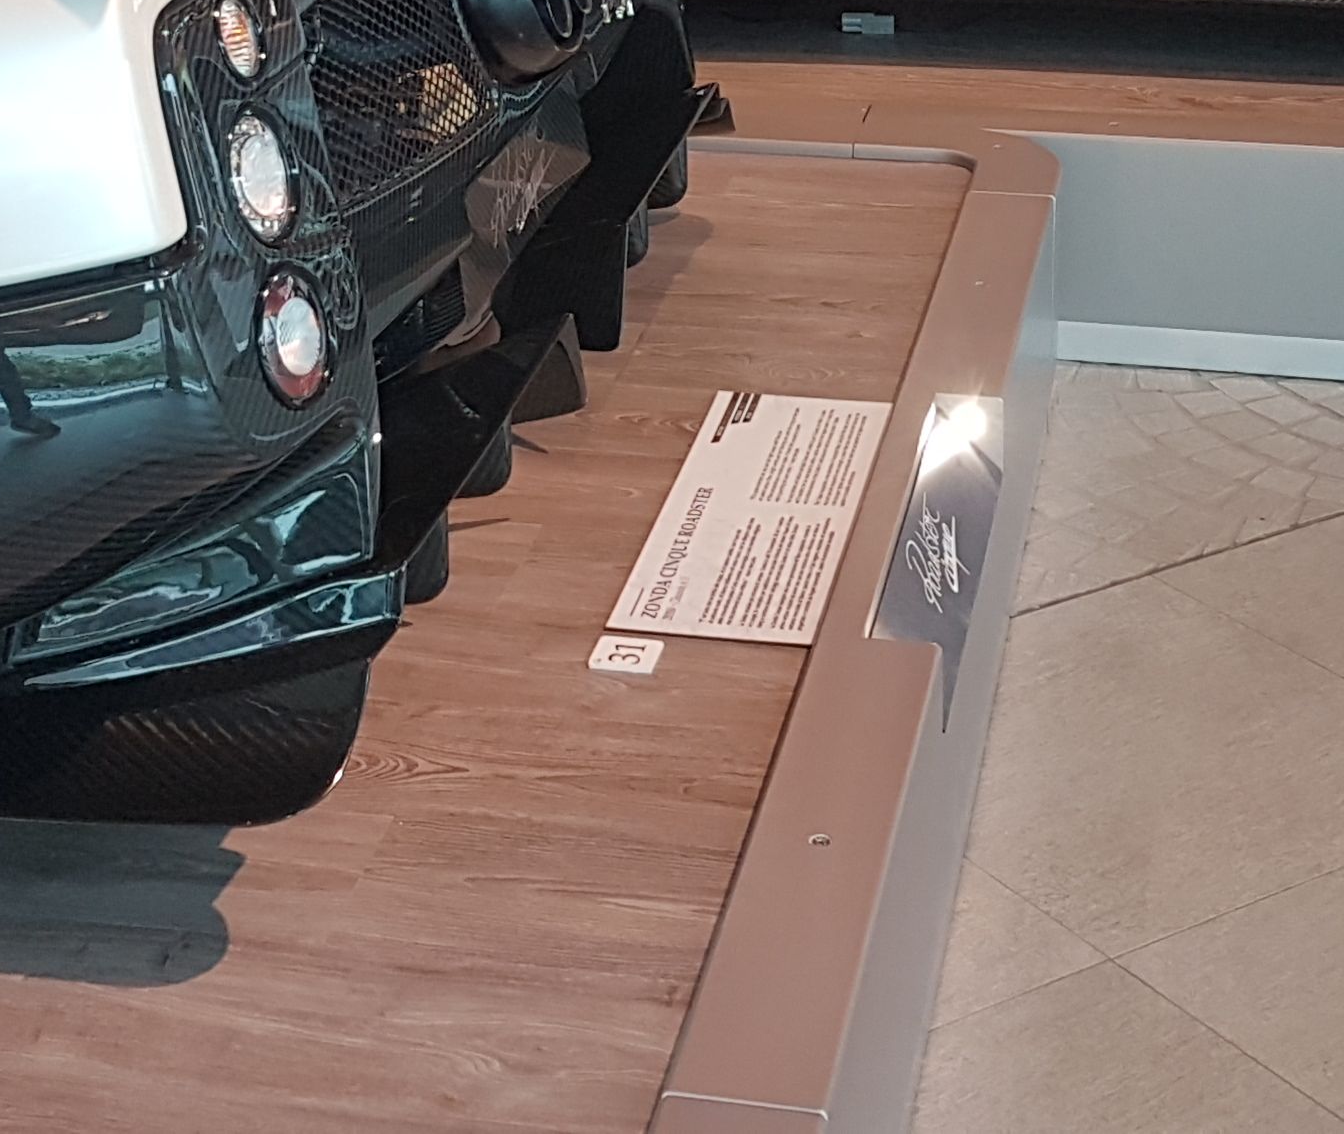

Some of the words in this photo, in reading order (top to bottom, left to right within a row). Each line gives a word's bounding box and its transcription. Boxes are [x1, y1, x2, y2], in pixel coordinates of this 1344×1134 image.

[641, 577, 670, 620] ZONDA
[659, 535, 691, 580] CINQUE
[678, 486, 715, 538] ROADSTER
[608, 643, 646, 666] 31
